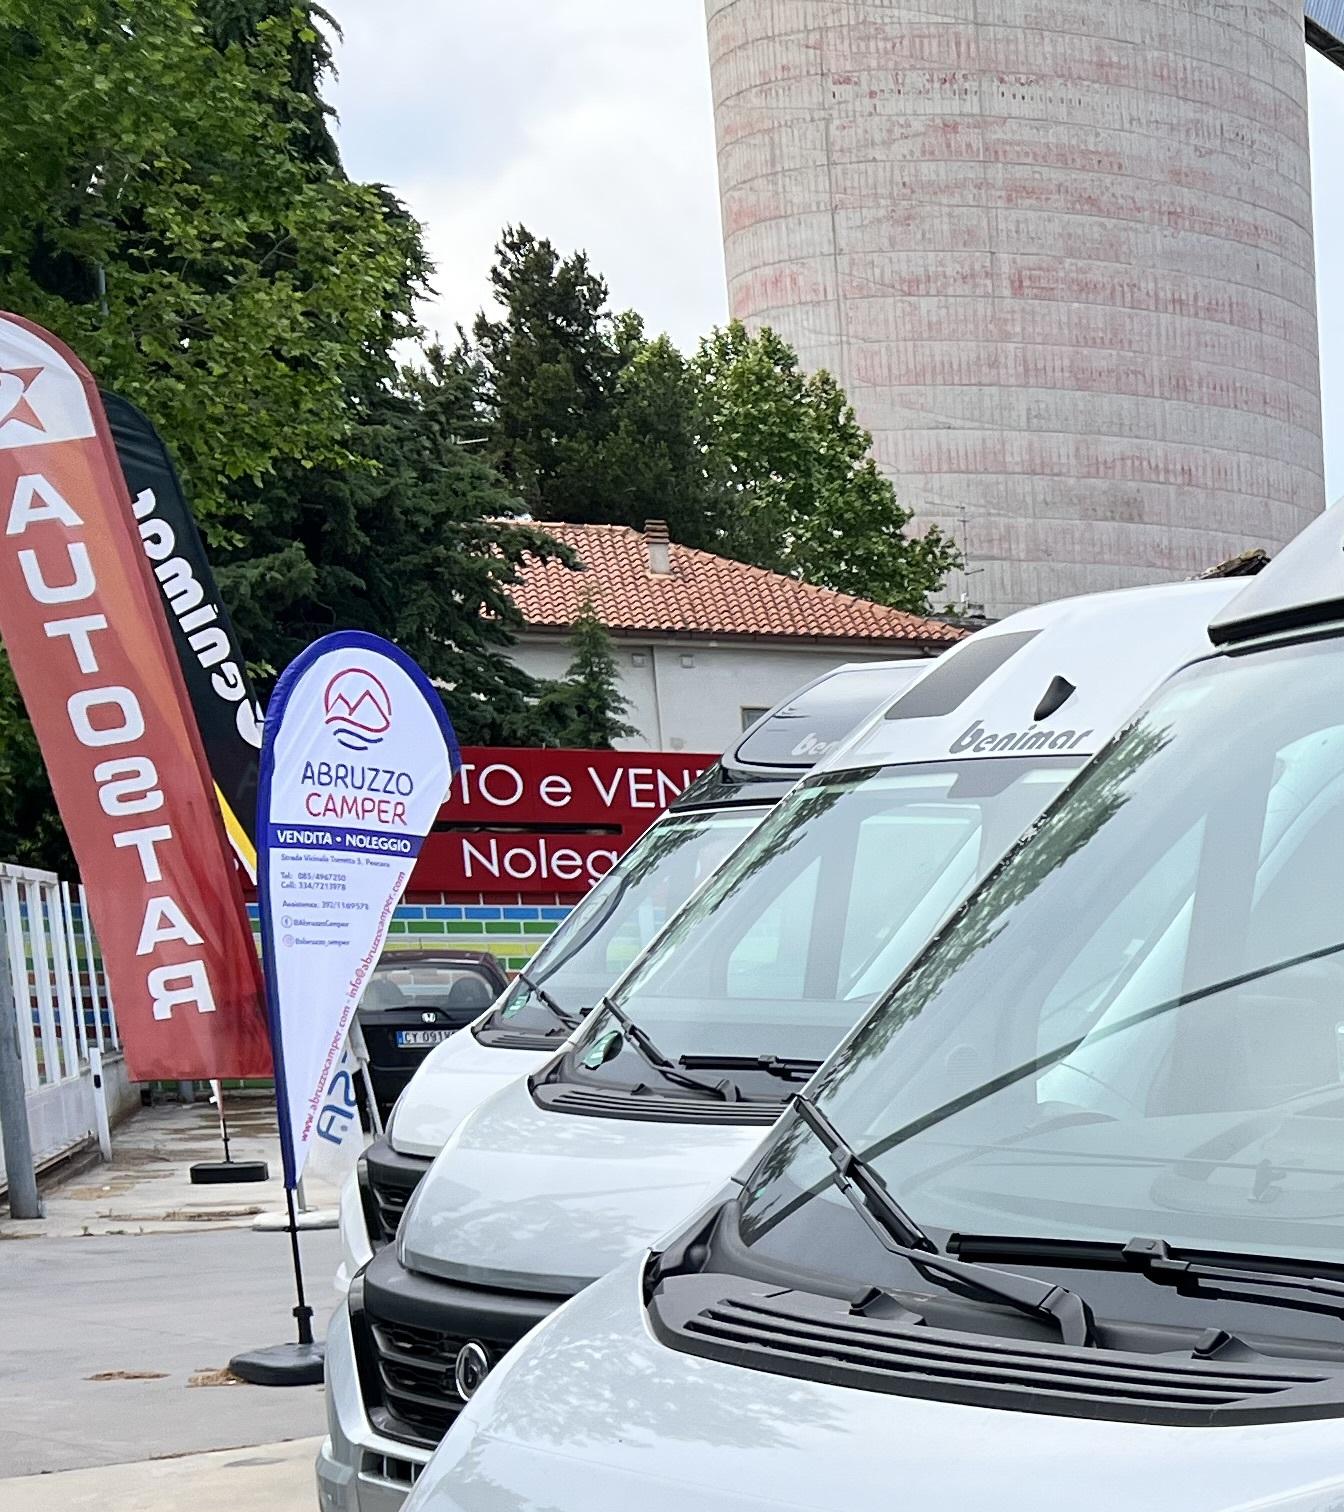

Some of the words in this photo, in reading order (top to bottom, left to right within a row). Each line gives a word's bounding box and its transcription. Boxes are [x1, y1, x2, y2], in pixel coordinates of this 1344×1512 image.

[949, 720, 1095, 754] benimar
[301, 761, 414, 797] ABRUZZO
[539, 775, 572, 807] e
[306, 792, 408, 826] CAMPER
[277, 830, 332, 845] VENDITA
[345, 833, 411, 853] NOLEGGIO
